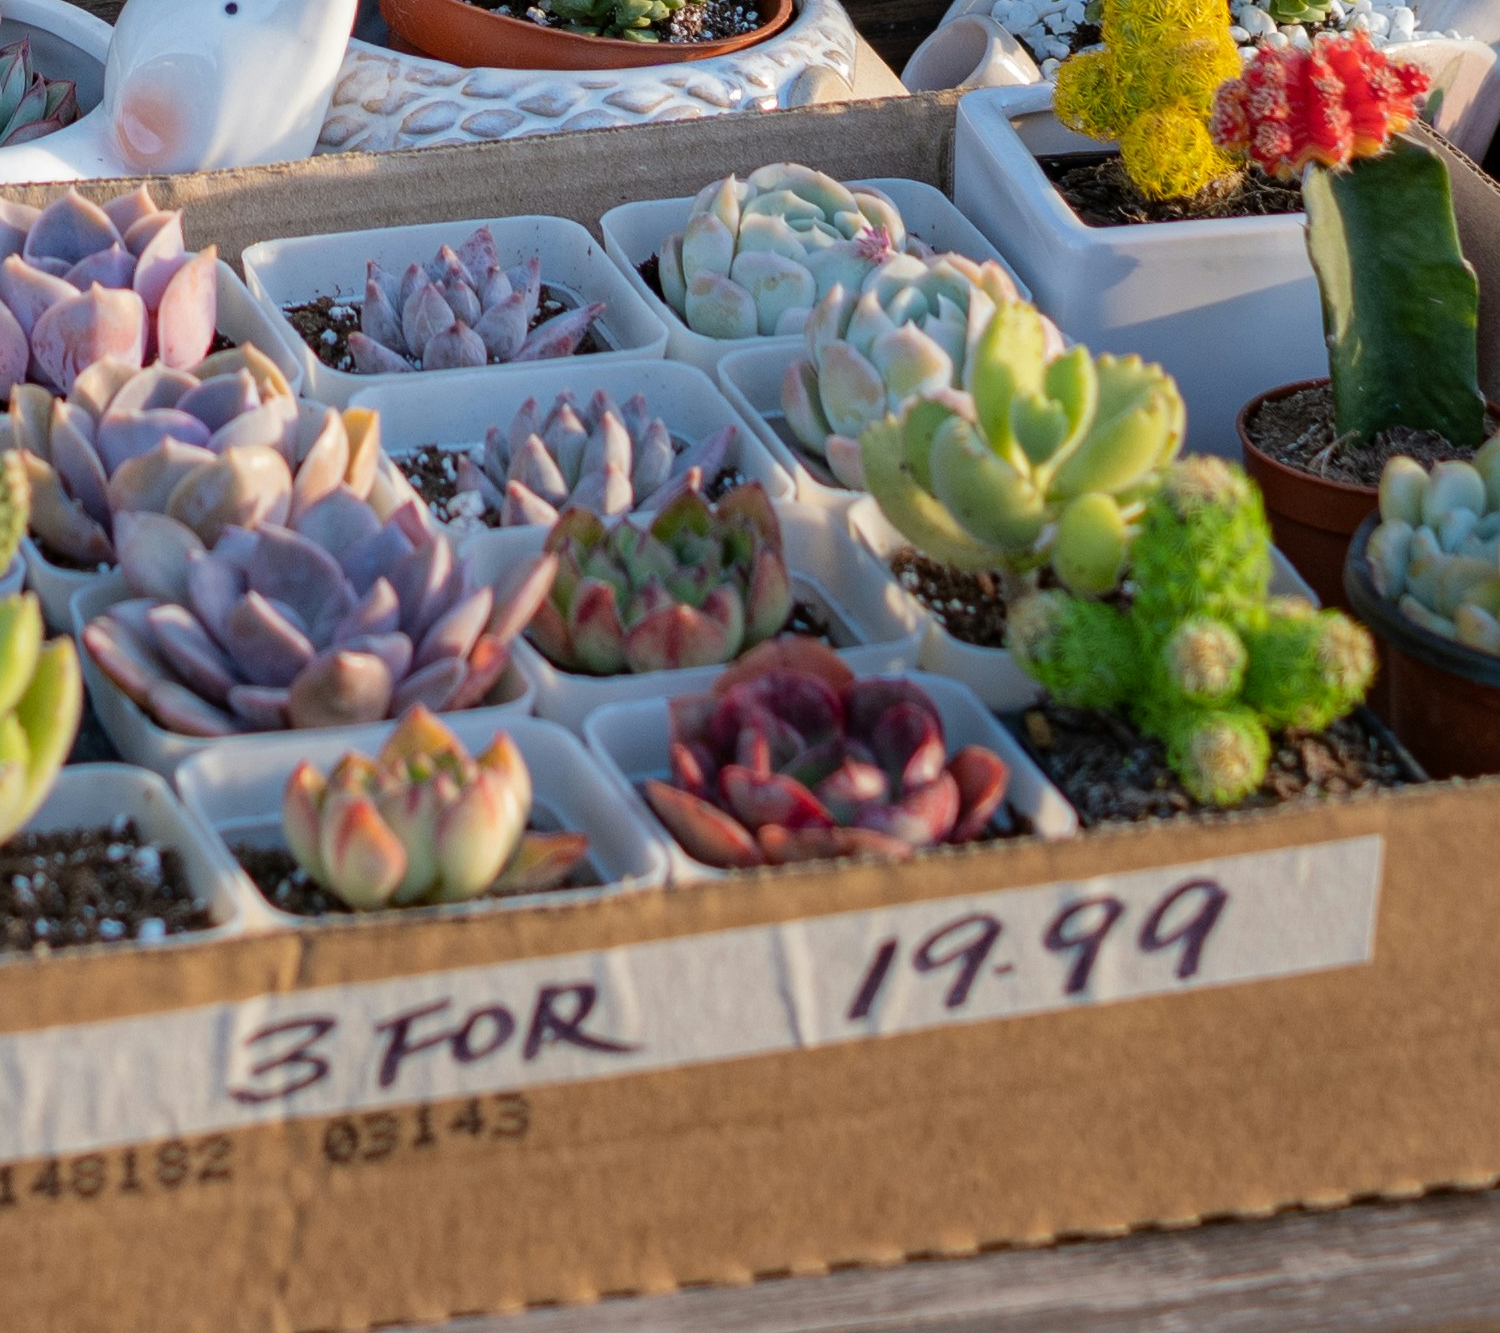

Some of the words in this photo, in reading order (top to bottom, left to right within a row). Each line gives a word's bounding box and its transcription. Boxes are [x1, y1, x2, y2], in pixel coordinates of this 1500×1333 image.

[228, 1012, 339, 1105] 3
[375, 982, 646, 1089] FOR
[847, 876, 1230, 1022] 19.99
